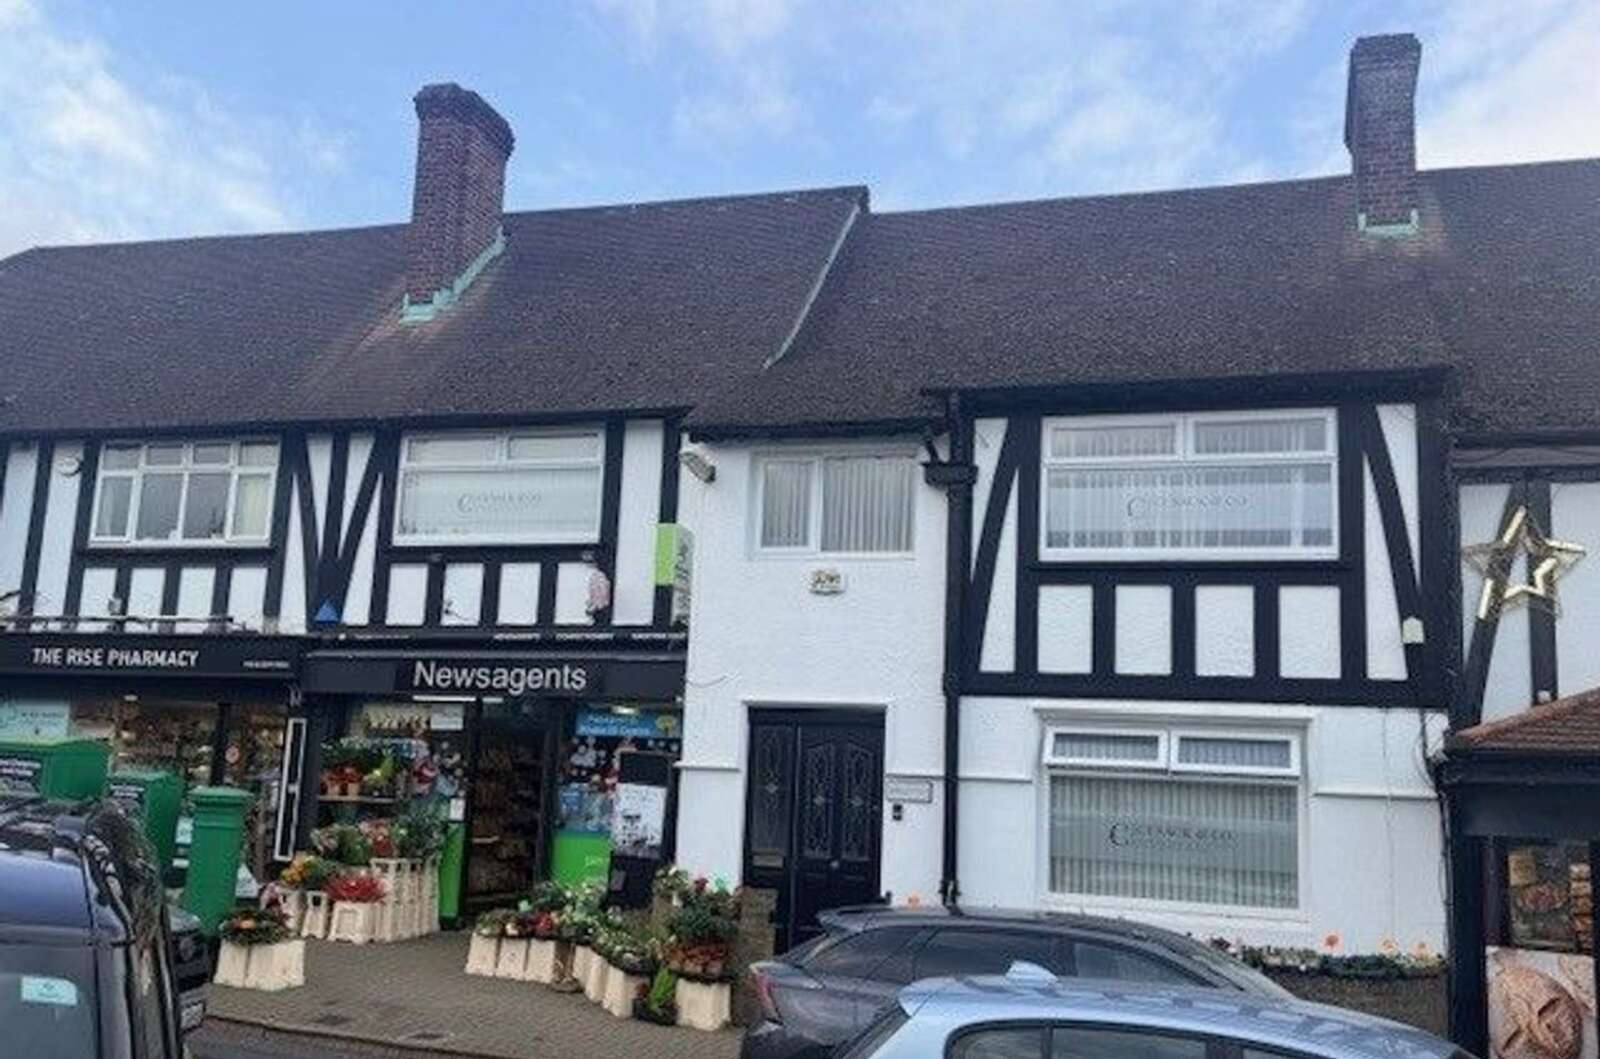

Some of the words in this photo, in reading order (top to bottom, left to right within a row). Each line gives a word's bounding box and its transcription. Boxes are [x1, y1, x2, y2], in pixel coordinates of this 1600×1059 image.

[31, 647, 64, 665] THE
[66, 648, 104, 666] RISE
[107, 649, 200, 668] PHARMACY
[412, 660, 588, 696] Newsagents
